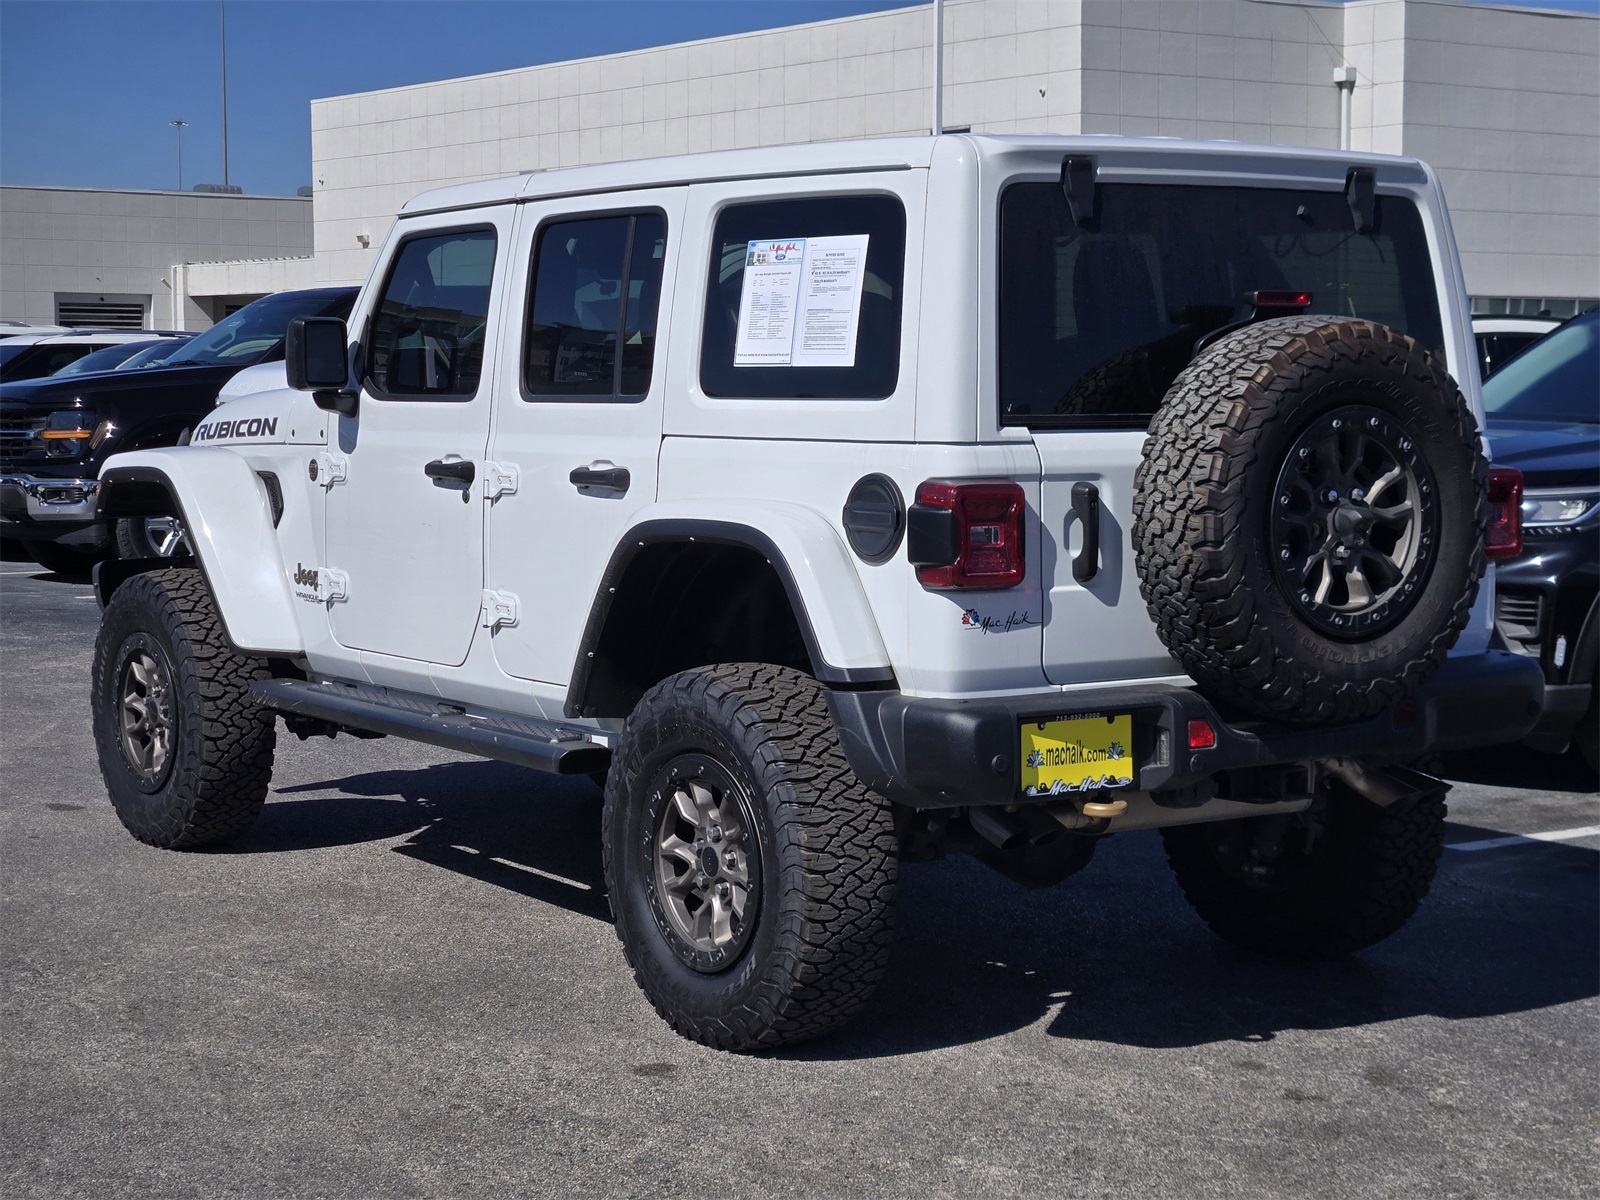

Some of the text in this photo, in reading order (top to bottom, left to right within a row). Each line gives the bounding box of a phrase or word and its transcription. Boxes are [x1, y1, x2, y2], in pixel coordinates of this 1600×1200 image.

[194, 417, 278, 441] RUBICON
[980, 611, 1038, 635] Mac Haik
[1045, 740, 1107, 767] machaik.com
[1048, 774, 1109, 795] Mac Haik
